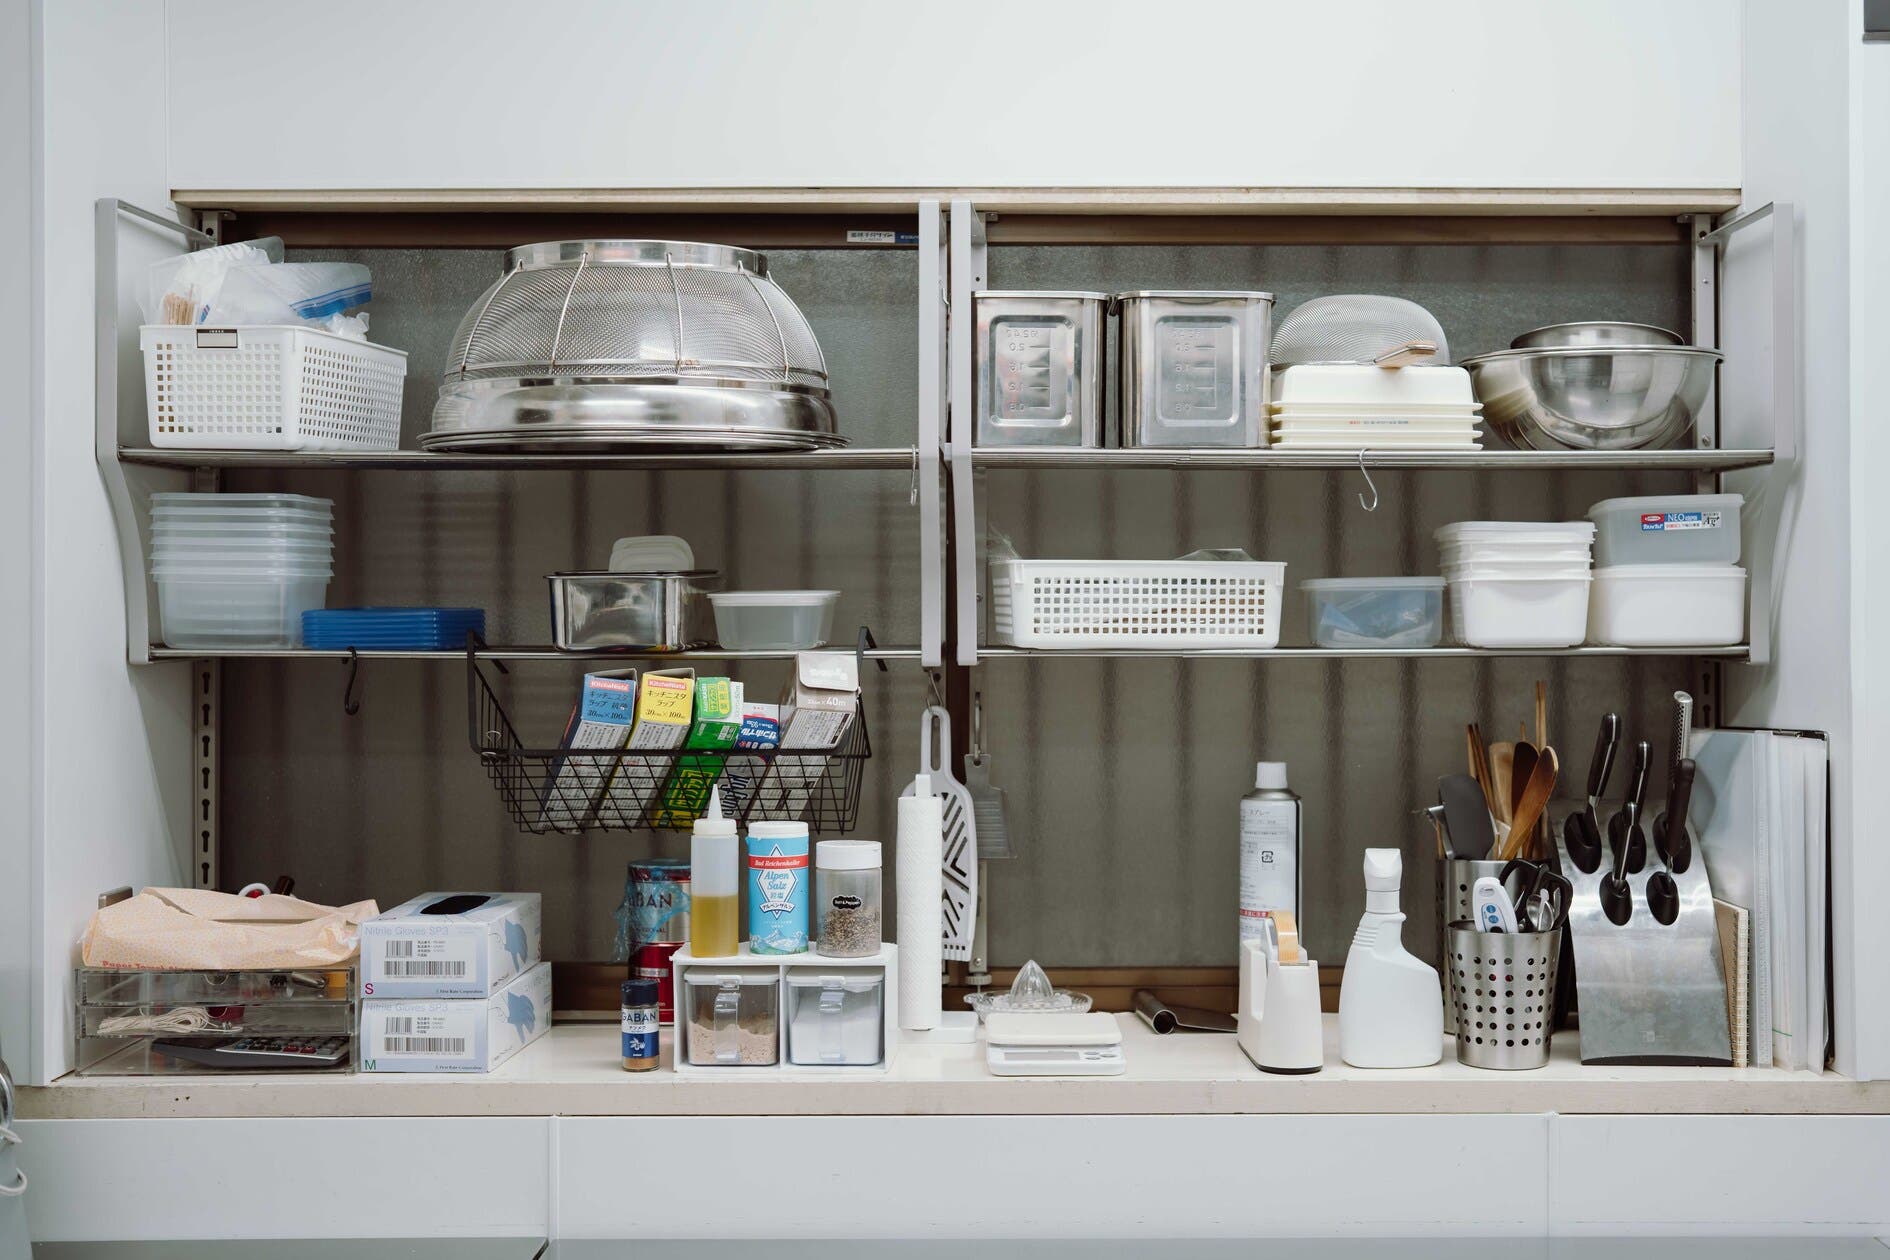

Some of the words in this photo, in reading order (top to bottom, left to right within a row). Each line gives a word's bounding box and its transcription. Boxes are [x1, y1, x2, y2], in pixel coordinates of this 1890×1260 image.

[647, 690, 687, 701] キッチニスタ
[741, 727, 777, 740] サンホイル
[764, 871, 790, 881] Alpen
[365, 926, 394, 936] Nitrile
[396, 926, 427, 936] Gloves
[365, 983, 374, 995] S
[621, 1011, 656, 1022] GABAN
[365, 1059, 376, 1071] M
